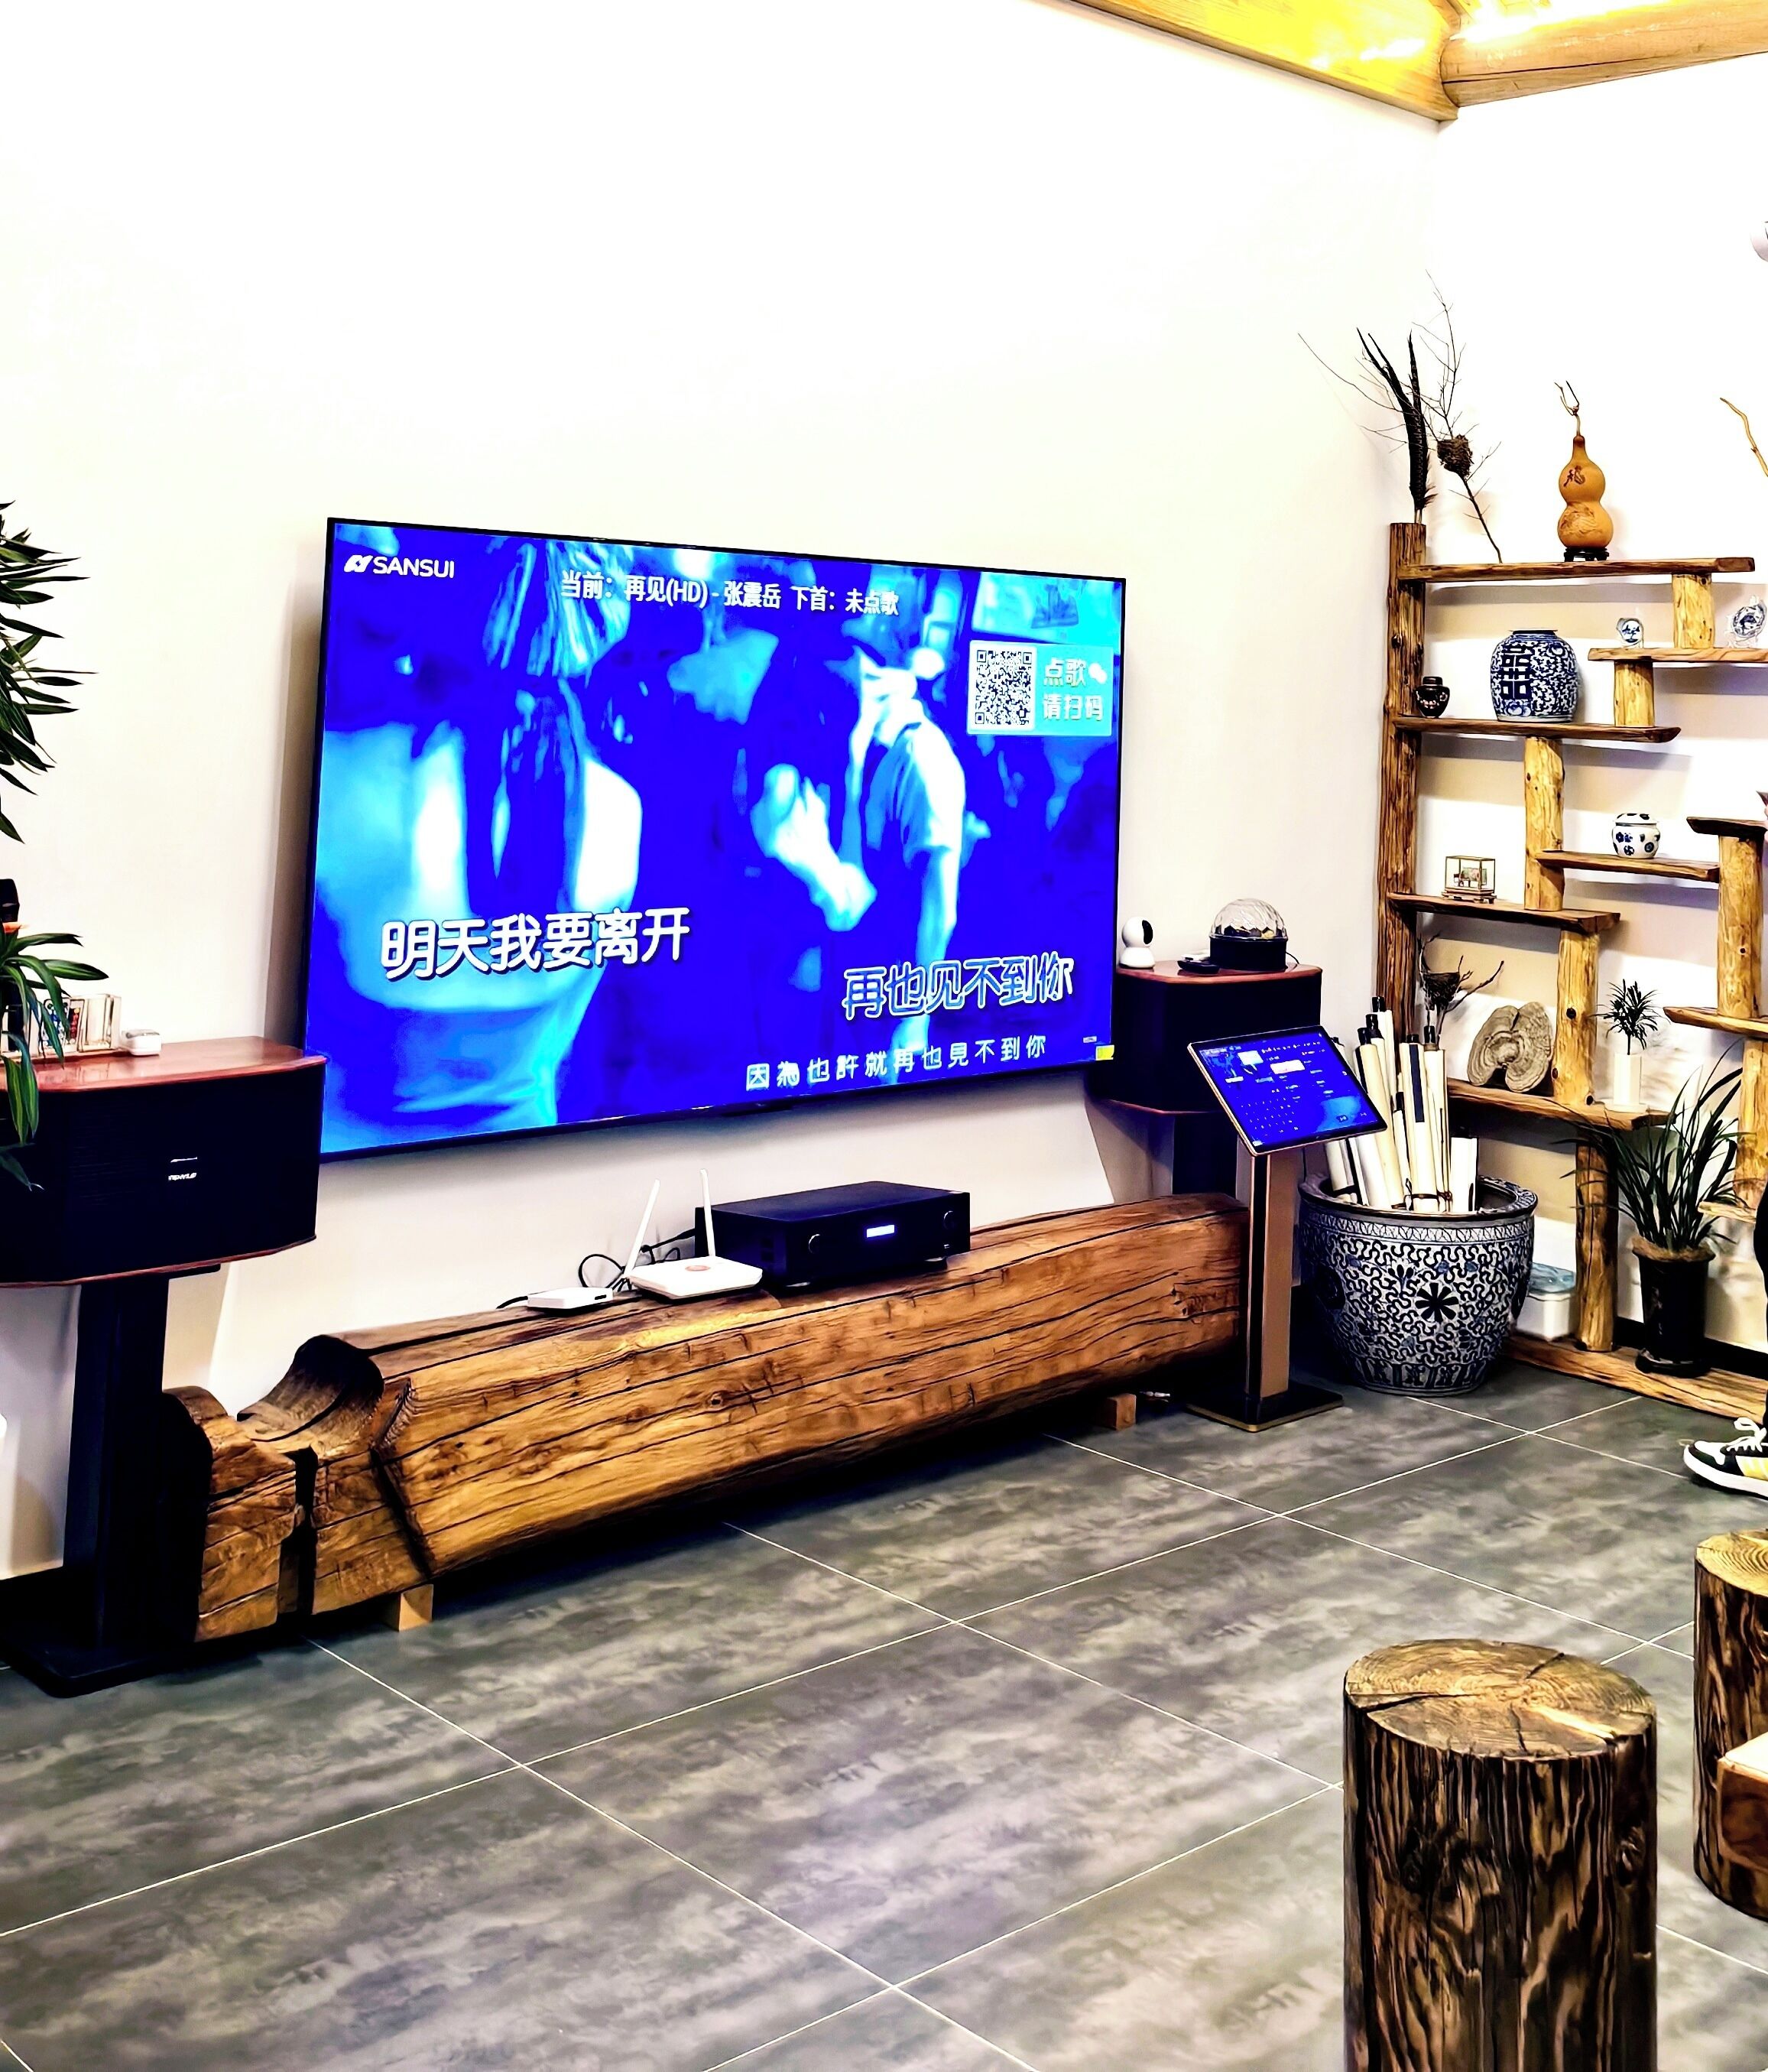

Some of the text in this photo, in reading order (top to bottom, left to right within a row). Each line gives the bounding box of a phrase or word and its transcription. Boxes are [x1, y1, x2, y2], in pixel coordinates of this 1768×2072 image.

[373, 557, 455, 579] SANSUI
[1043, 658, 1086, 687] 点歌
[1043, 693, 1103, 721] 请扫码
[381, 907, 691, 981] 明天我要离开
[842, 950, 1075, 1021] 再也见不到你
